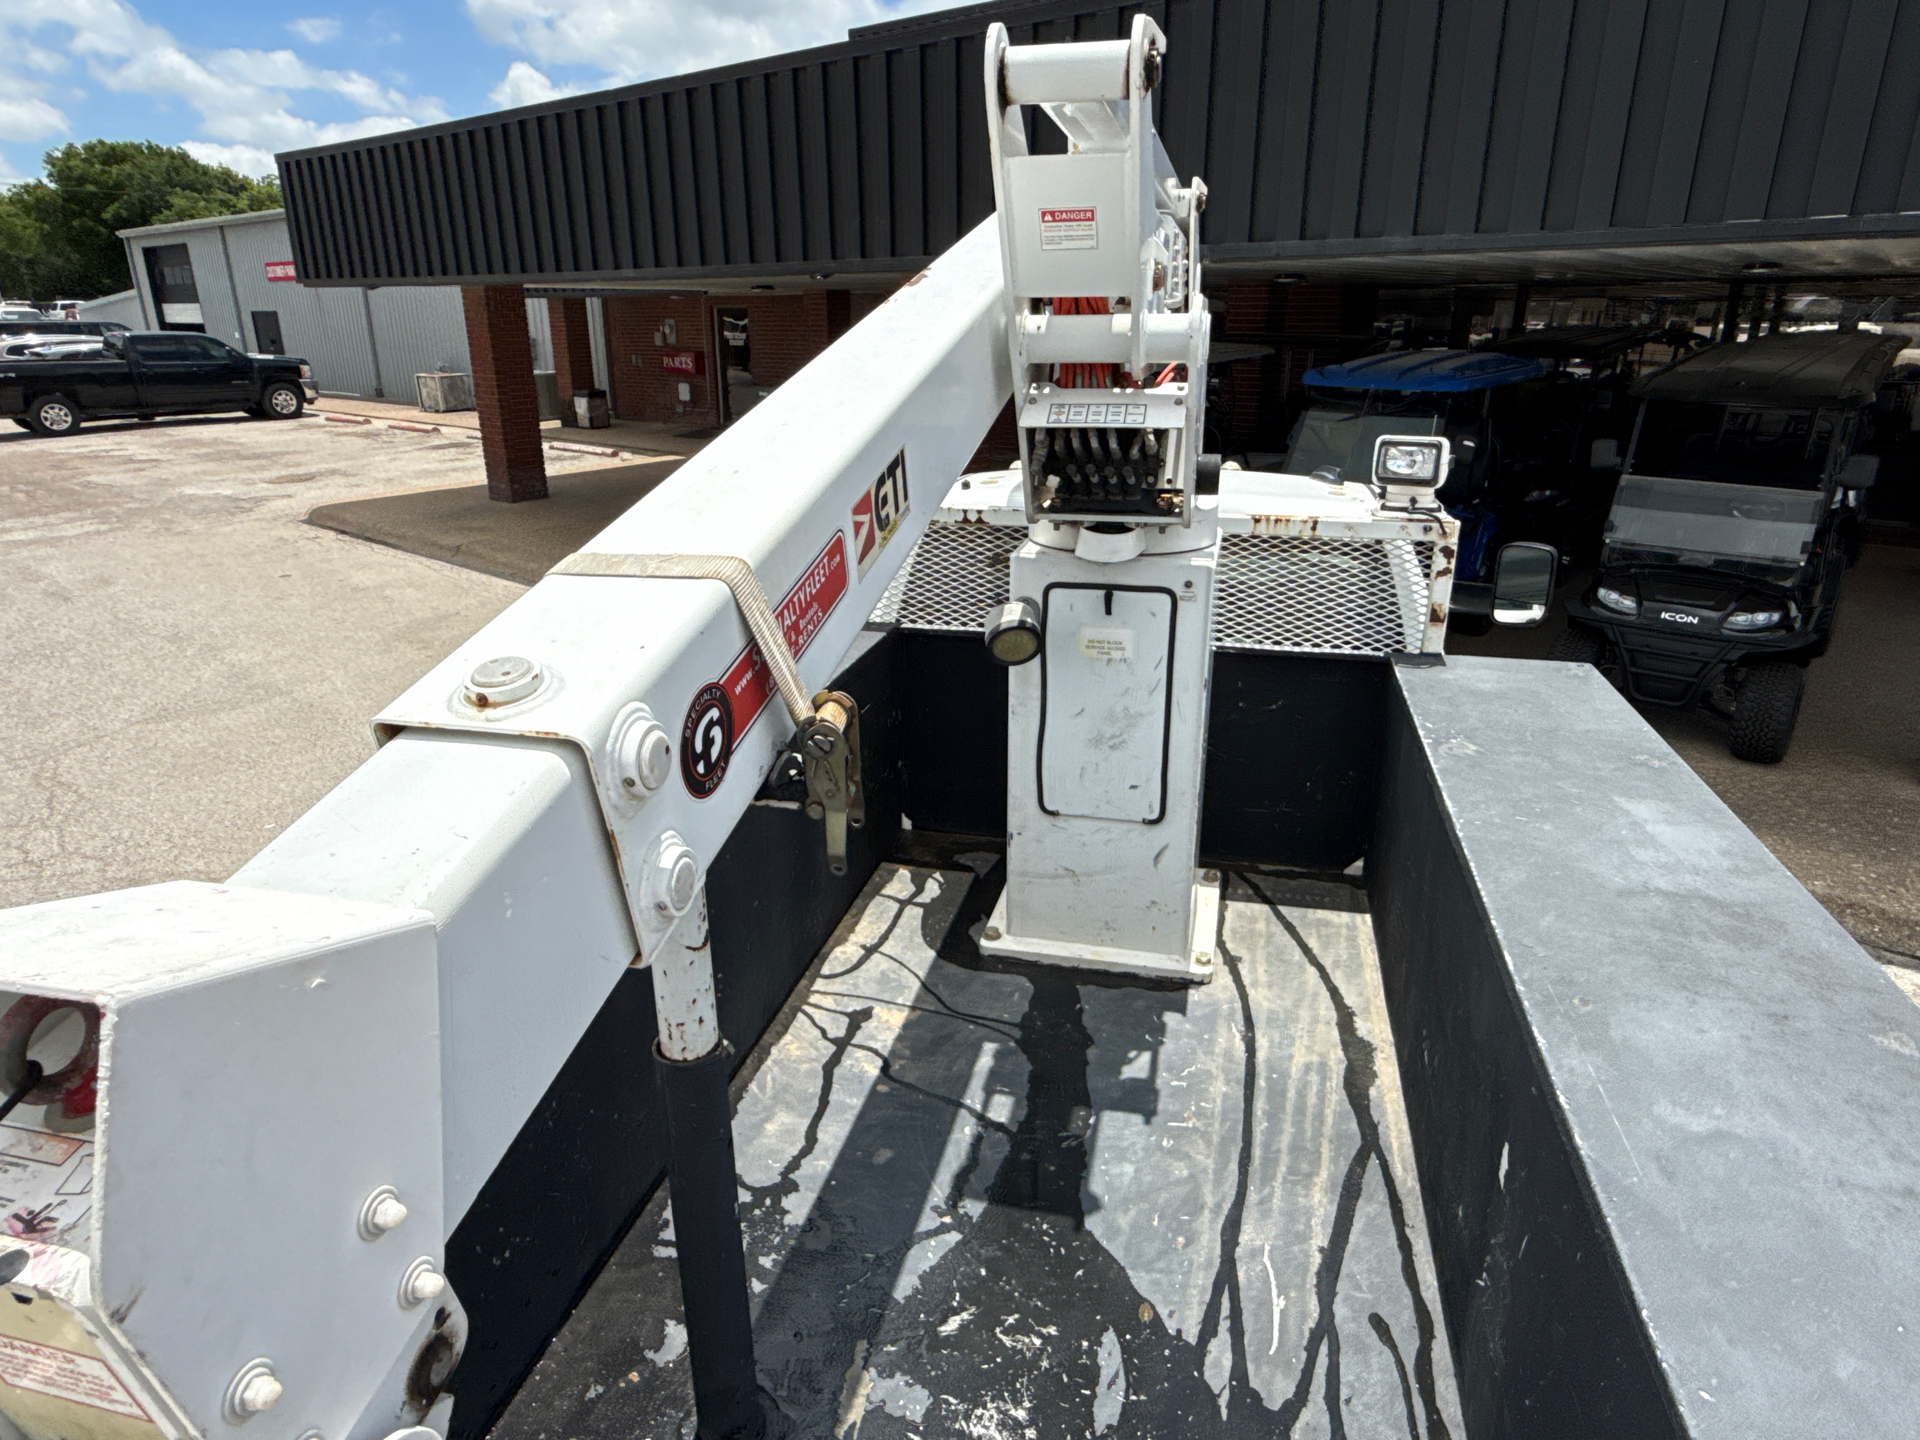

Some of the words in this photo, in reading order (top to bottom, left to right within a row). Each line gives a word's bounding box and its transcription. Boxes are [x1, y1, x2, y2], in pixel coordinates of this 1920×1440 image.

[1055, 211, 1092, 220] DANGER
[662, 356, 693, 369] PARTS
[1660, 611, 1699, 625] ICON
[685, 689, 721, 738] SPECIALTY
[705, 761, 726, 791] FLEET
